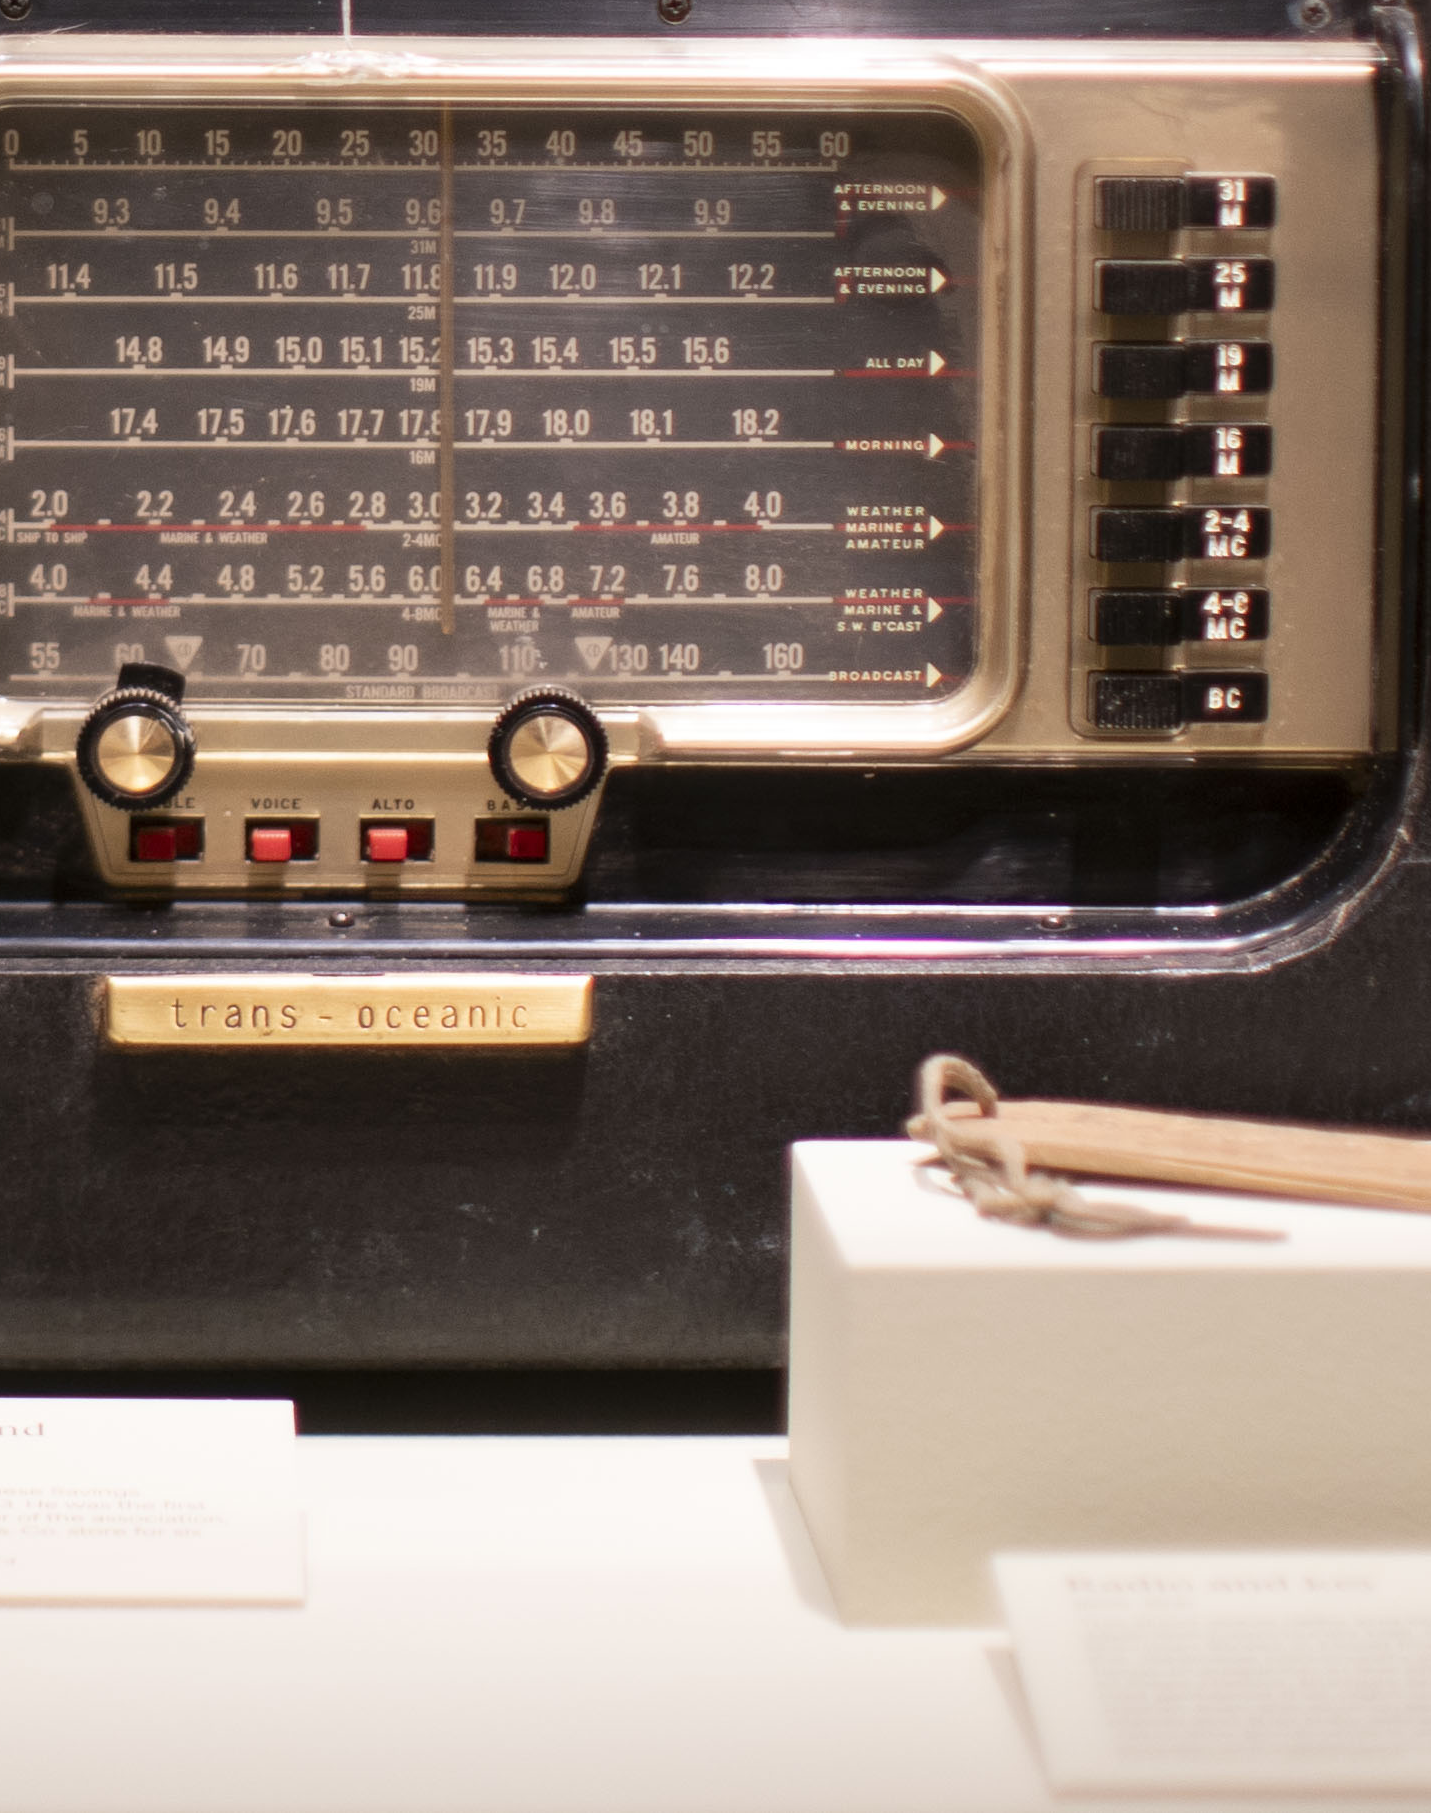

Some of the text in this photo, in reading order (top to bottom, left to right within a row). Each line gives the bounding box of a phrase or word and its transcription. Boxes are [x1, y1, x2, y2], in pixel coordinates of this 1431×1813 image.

[5, 130, 848, 157] 0 5 10 15 20 25 30 35 40 45 50 55 60
[834, 185, 927, 194] AFTERNOON
[1219, 180, 1246, 201] 31
[840, 201, 926, 211] & EVENING
[1220, 205, 1242, 226] M
[49, 263, 91, 290] 11.4
[155, 263, 197, 290] 11.5
[256, 263, 298, 290] 11.6
[328, 263, 370, 290] 11.7
[474, 263, 517, 290] 11.9
[550, 263, 596, 290] 12.0
[639, 263, 682, 290] 12.1
[729, 263, 774, 290] 12.2
[834, 267, 926, 277] AFTERNOON
[1215, 263, 1247, 283] 25
[839, 284, 926, 294] & EVENING
[1219, 289, 1241, 308] M
[866, 358, 924, 368] ALL DAY
[1218, 345, 1242, 366] 19
[1219, 371, 1241, 391] M
[846, 441, 924, 451] MORNING
[1216, 428, 1241, 449] 16
[1218, 454, 1240, 475] M
[32, 491, 67, 518] 2.0
[138, 491, 173, 518] 2.2
[219, 491, 256, 518] 2.4
[289, 491, 324, 518] 2.6
[350, 491, 385, 518] 2.8
[466, 491, 501, 518] 3.2
[528, 491, 565, 518] 3.4
[590, 491, 626, 518] 3.6
[663, 491, 699, 518] 3.8
[744, 491, 781, 518] 4.0
[847, 507, 925, 516] WEATHER
[846, 523, 924, 533] MARINE &
[1205, 510, 1250, 532] 2-4
[846, 539, 924, 549] AMATEUR
[1208, 536, 1247, 557] MC
[845, 589, 923, 599] WEATHER
[1203, 592, 1249, 614] 4-8
[844, 605, 922, 615] MARINE &
[1207, 619, 1246, 639] MC
[829, 671, 921, 681] BROADCAST
[1208, 689, 1241, 708] BC
[251, 797, 303, 810] VOICE
[372, 797, 415, 811] ALTO
[172, 997, 297, 1029] trans
[357, 997, 527, 1029] oceanic
